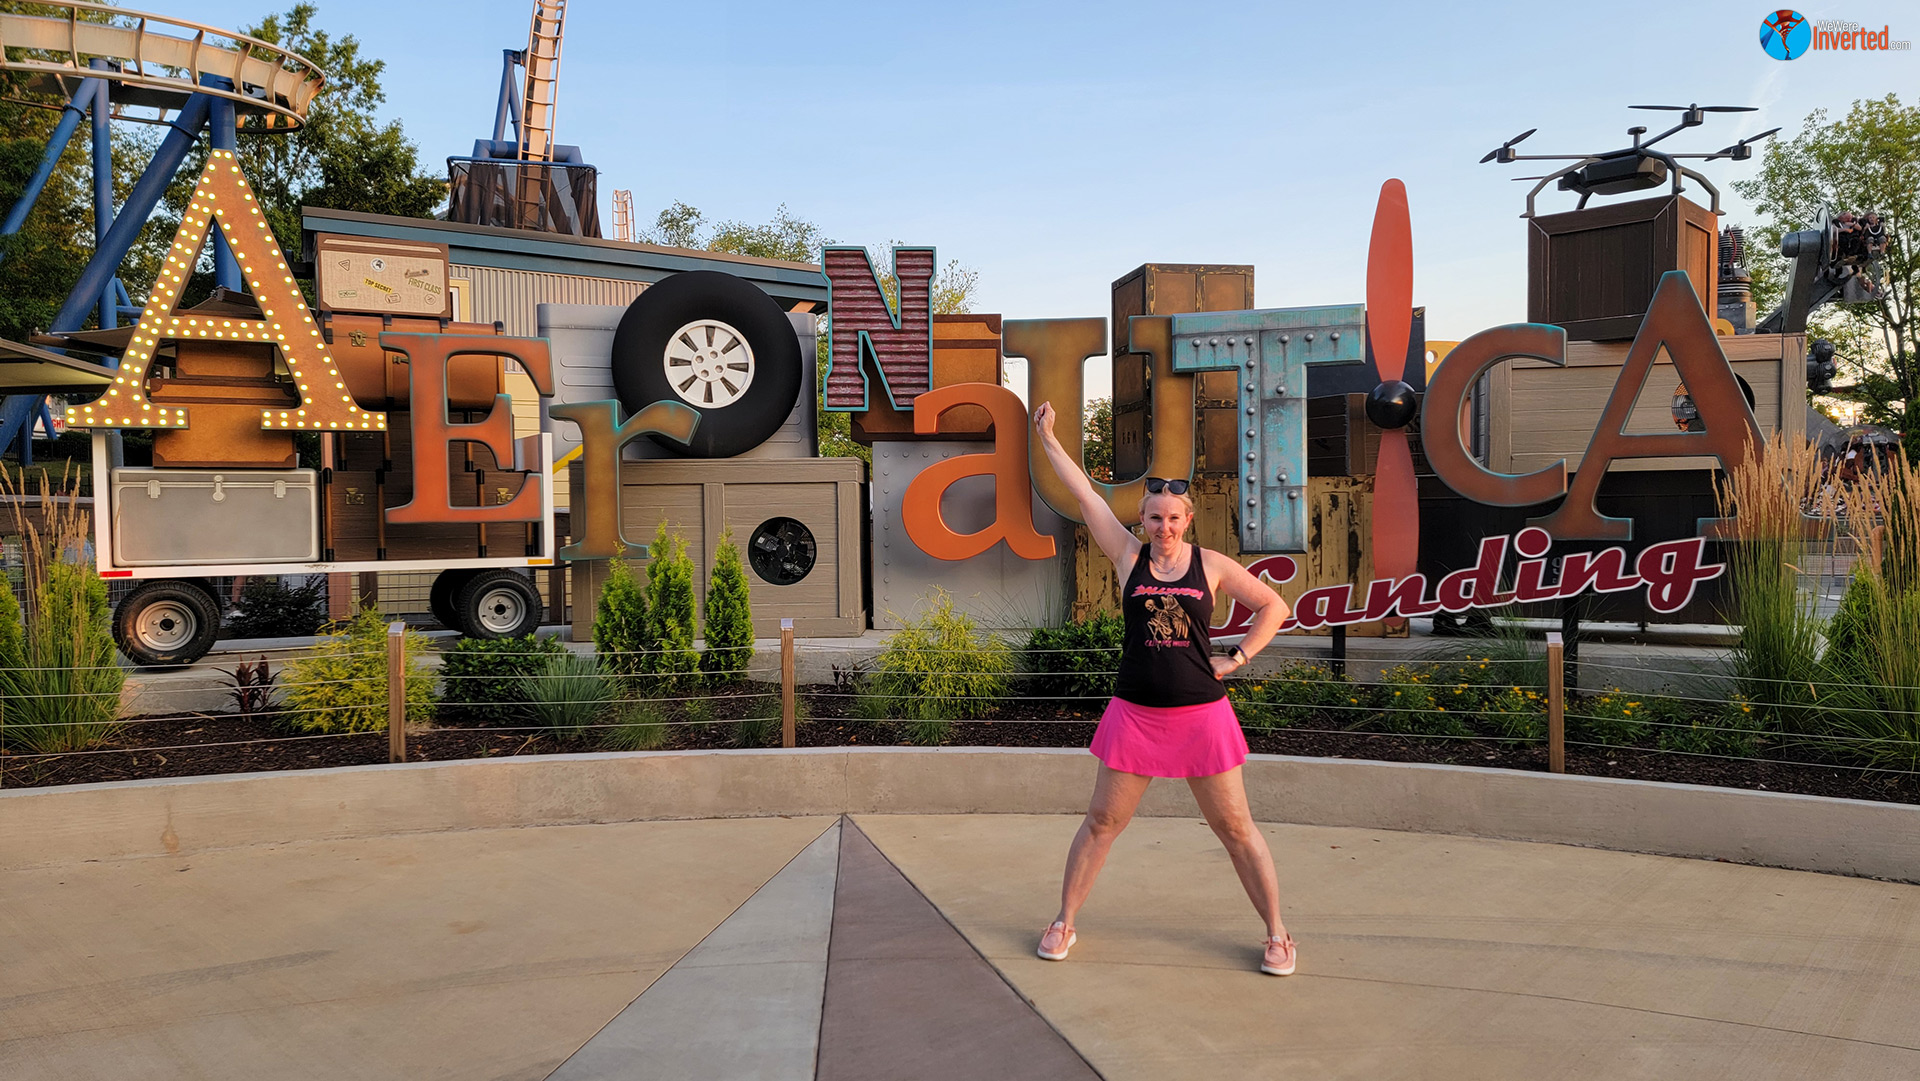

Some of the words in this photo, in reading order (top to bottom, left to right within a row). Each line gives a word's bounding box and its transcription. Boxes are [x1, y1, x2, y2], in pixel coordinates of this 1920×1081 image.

[365, 278, 375, 287] TOP
[374, 282, 392, 293] SECRET
[408, 278, 425, 289] FIRST
[424, 282, 442, 295] CLASS
[1210, 526, 1726, 638] Landing
